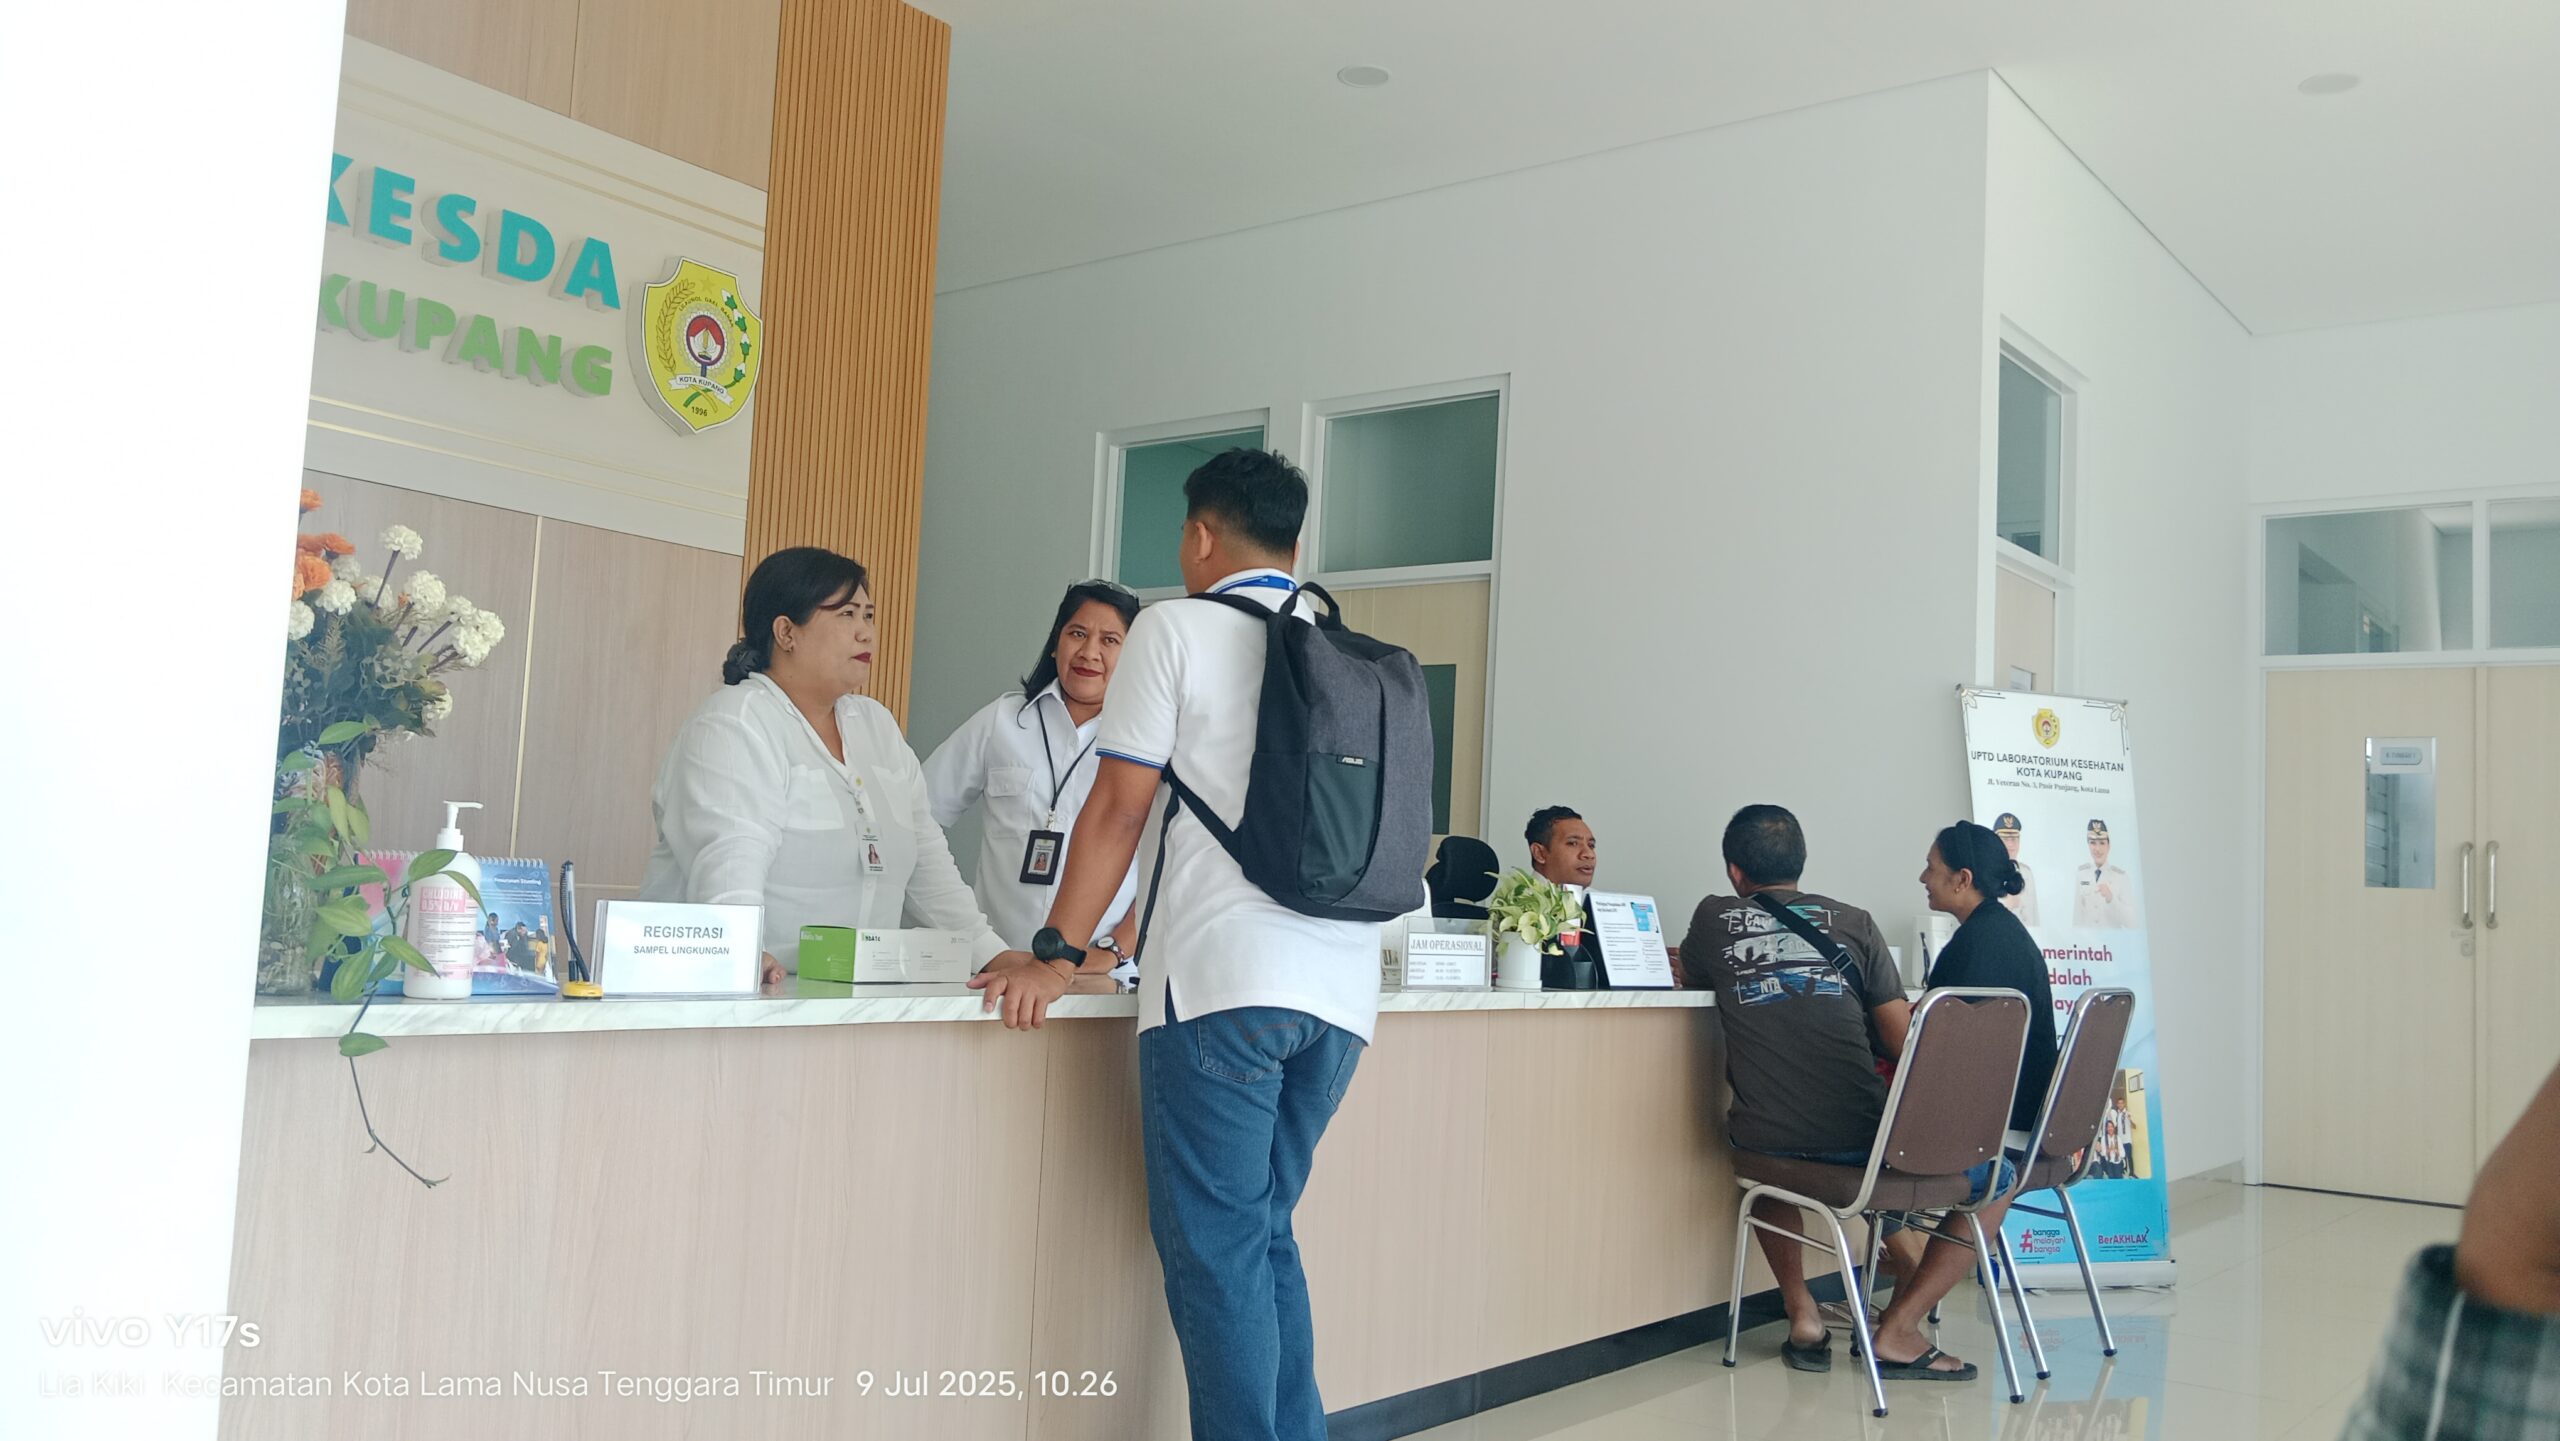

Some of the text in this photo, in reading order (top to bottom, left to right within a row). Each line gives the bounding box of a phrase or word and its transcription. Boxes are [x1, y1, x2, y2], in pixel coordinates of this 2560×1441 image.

[319, 272, 613, 397] KUPANG
[679, 376, 724, 395] KOTA KUPANG
[691, 406, 708, 416] 1996
[1971, 750, 2124, 772] UPTD LABORATORIUM KESEHATAN
[2016, 767, 2083, 781] KOTA KUPANG
[644, 926, 723, 939] REGISTRASI
[634, 945, 730, 955] SAMPEL LINGKUNGAN
[1411, 939, 1484, 952] JAM OPERASIONAL
[2098, 1234, 2149, 1245] BerAKHLAK
